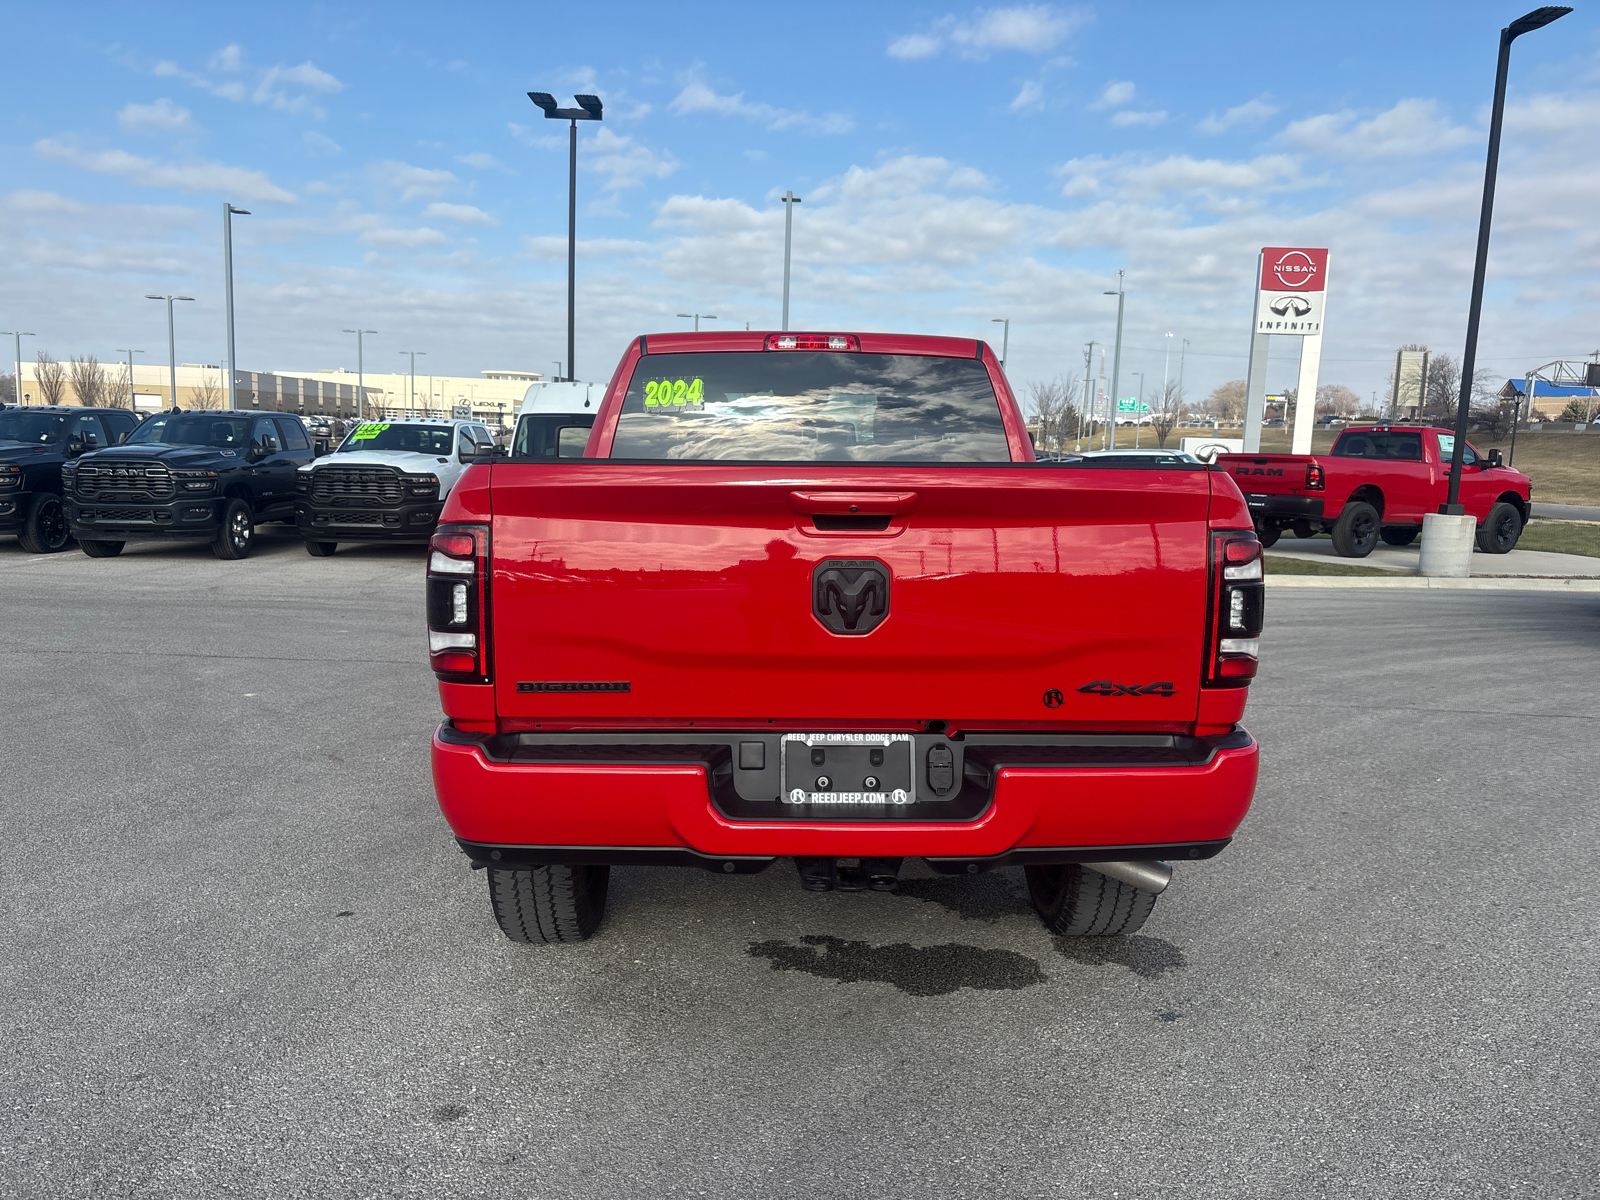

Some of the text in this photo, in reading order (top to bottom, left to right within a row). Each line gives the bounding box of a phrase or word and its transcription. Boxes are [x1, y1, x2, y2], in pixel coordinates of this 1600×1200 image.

[1260, 321, 1319, 331] INFINITI
[645, 378, 703, 408] 2024
[473, 400, 507, 408] LEXUS
[1235, 467, 1284, 477] RAM
[829, 560, 875, 568] RAM
[1076, 680, 1178, 697] 4x4
[787, 733, 909, 741] REED JEEP CHRYSLER DODGE RAM
[811, 792, 886, 804] REEDJEEP.COM
